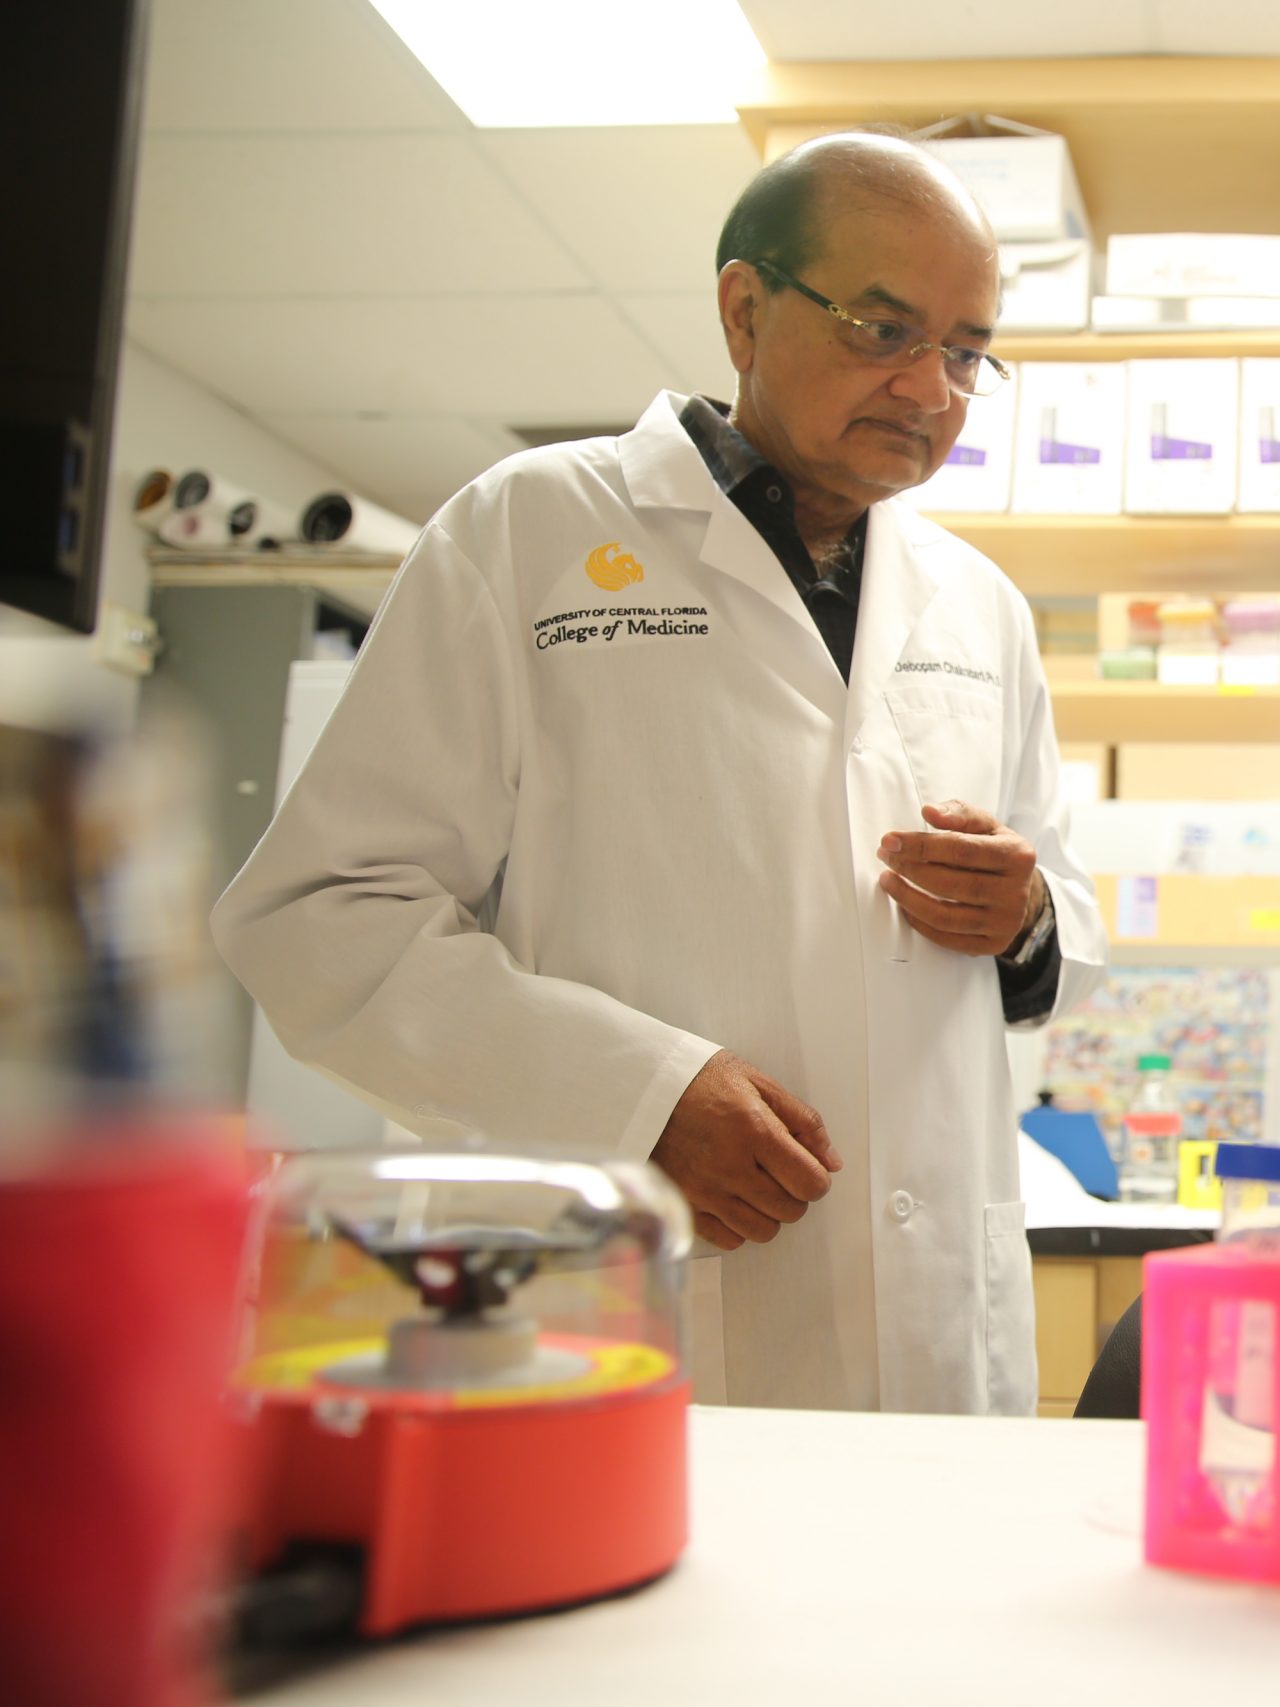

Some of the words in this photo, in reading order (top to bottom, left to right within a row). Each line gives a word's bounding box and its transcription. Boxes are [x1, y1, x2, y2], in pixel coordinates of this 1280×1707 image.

[534, 609, 590, 631] UNIVERSITY
[592, 608, 607, 617] OF
[609, 607, 659, 616] CENTRAL
[661, 607, 708, 615] FLORIDA
[536, 625, 598, 650] College
[602, 620, 623, 641] of
[627, 619, 709, 635] Medicine
